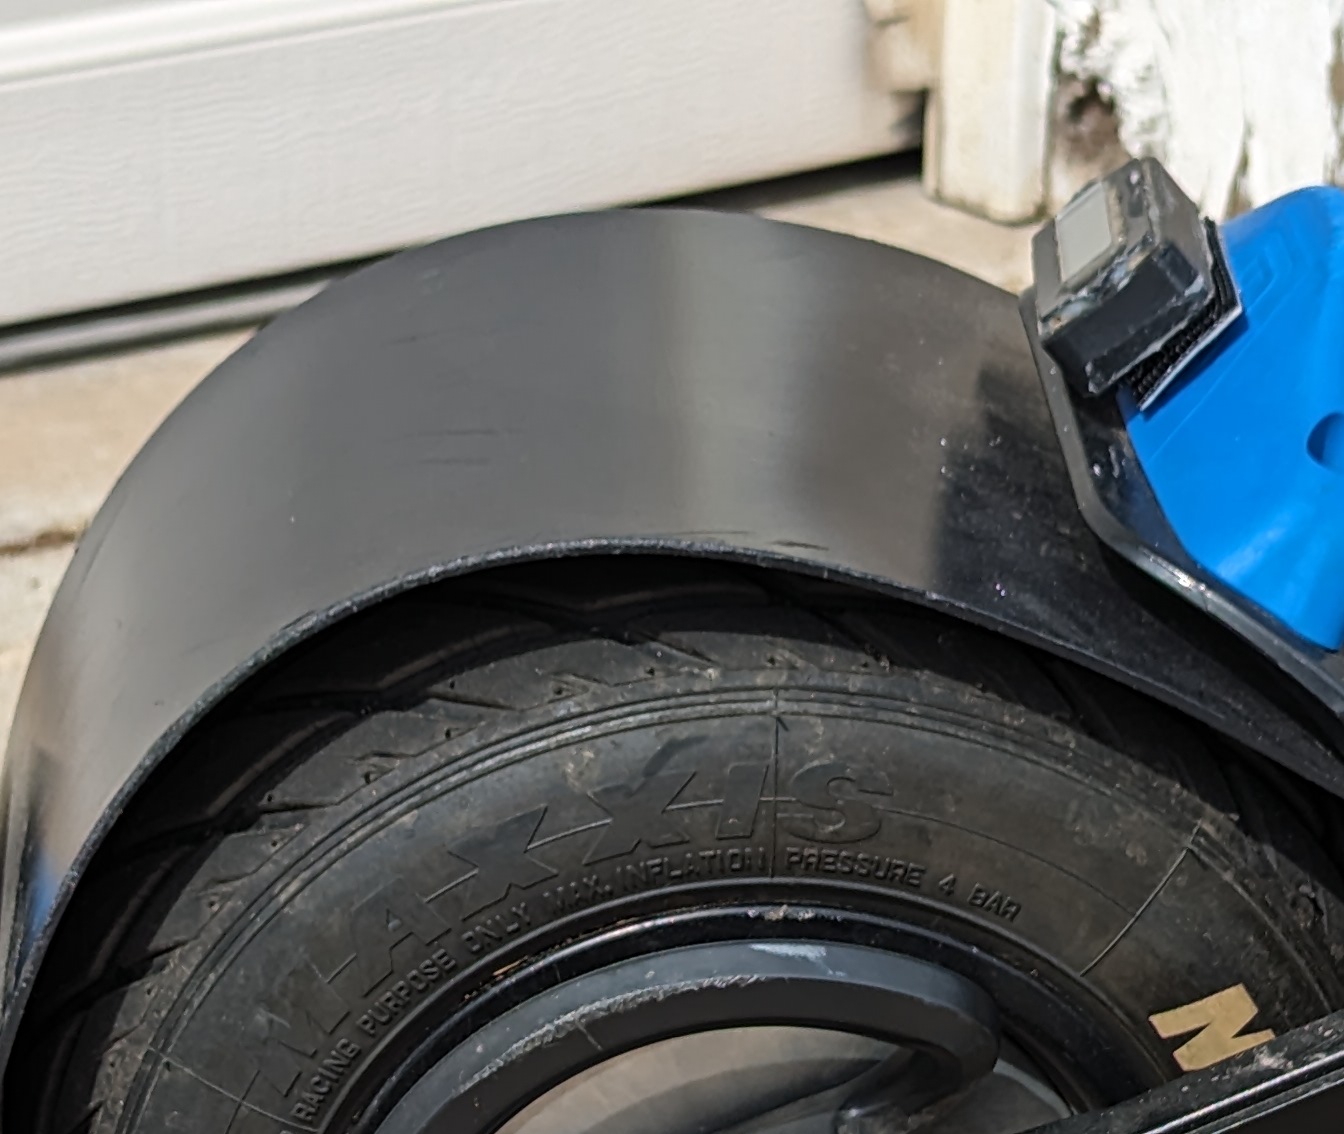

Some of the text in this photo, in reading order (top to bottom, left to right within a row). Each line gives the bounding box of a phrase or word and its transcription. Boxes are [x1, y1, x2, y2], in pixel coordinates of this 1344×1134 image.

[234, 757, 895, 1098] MAXXIS
[290, 1037, 361, 1122] RACING
[356, 947, 457, 1036] PURPOSE
[459, 900, 533, 952] ONLY
[614, 845, 767, 892] INFLATION
[784, 844, 928, 888] PRESSURE
[937, 871, 959, 897] 4
[965, 881, 1023, 923] BAR
